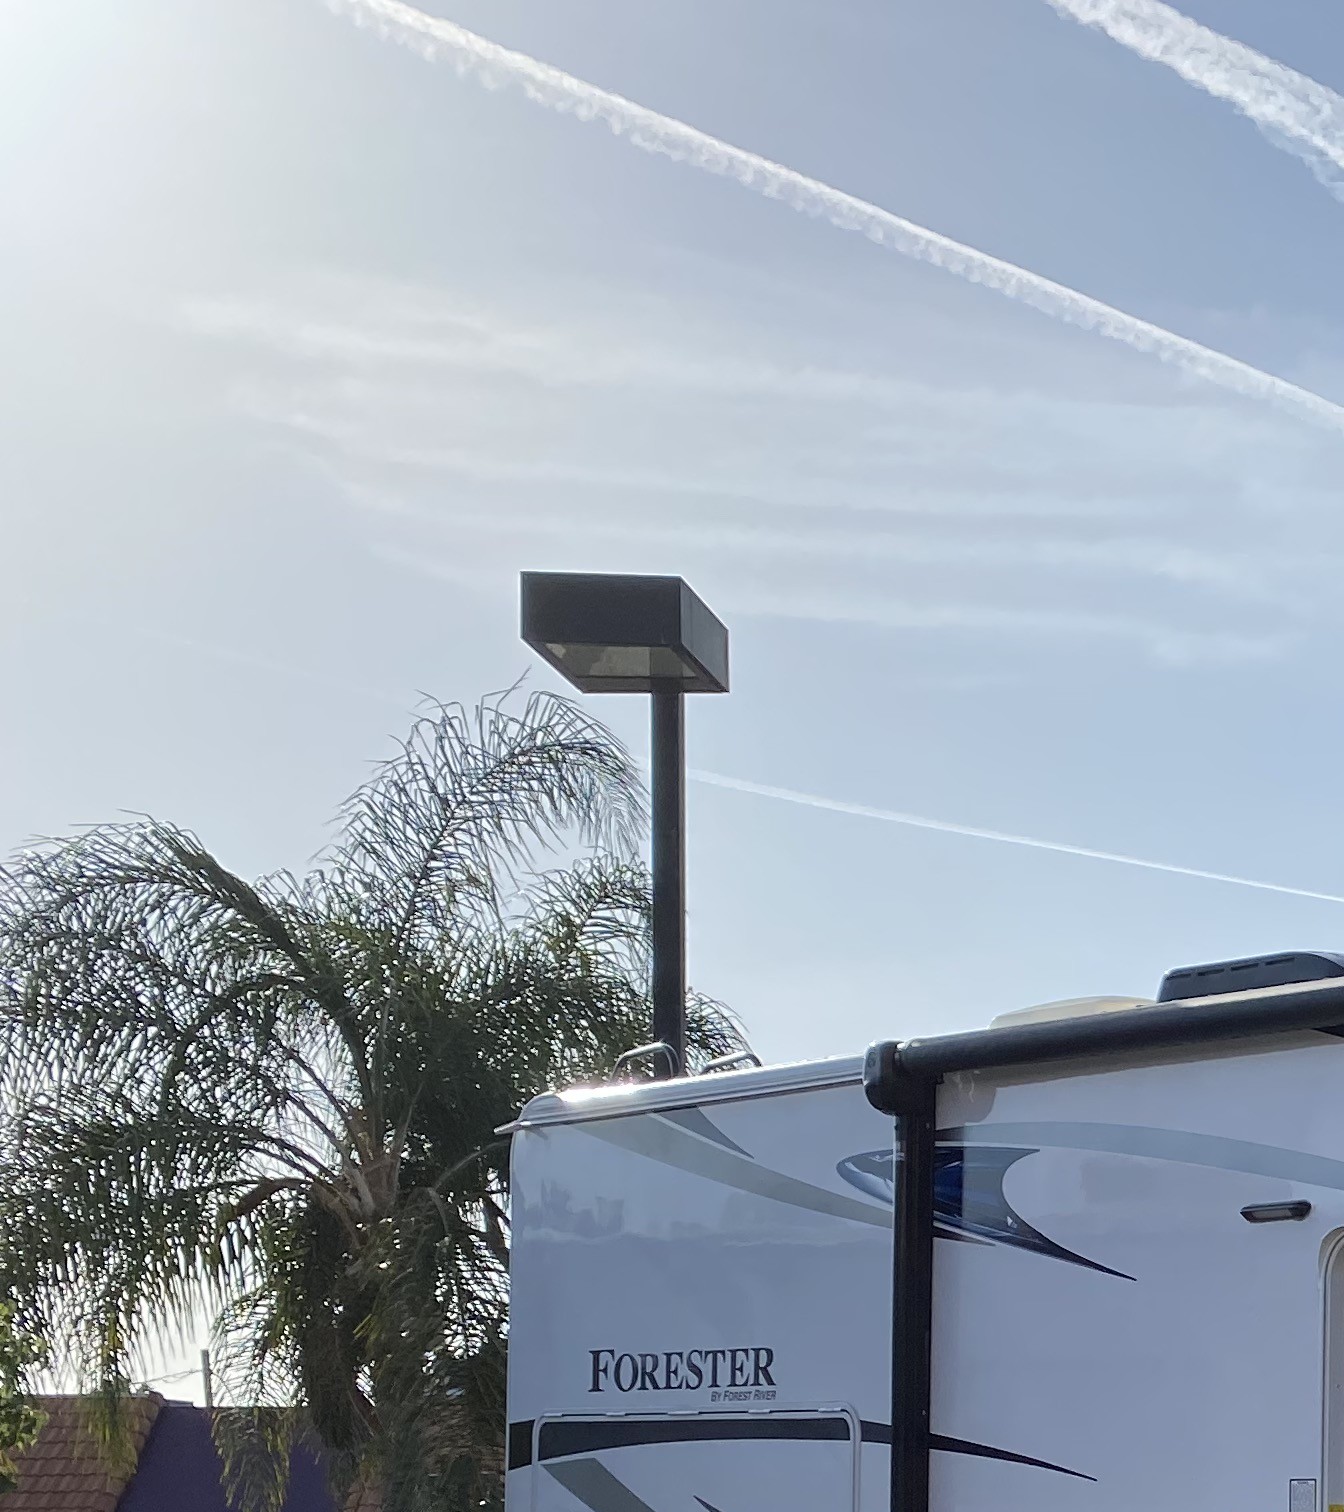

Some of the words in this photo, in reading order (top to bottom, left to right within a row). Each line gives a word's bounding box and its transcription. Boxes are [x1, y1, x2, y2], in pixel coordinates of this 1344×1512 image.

[588, 1347, 777, 1393] FORESTER
[711, 1390, 722, 1402] BY
[723, 1390, 753, 1402] FOREST
[753, 1389, 777, 1401] RIVER
